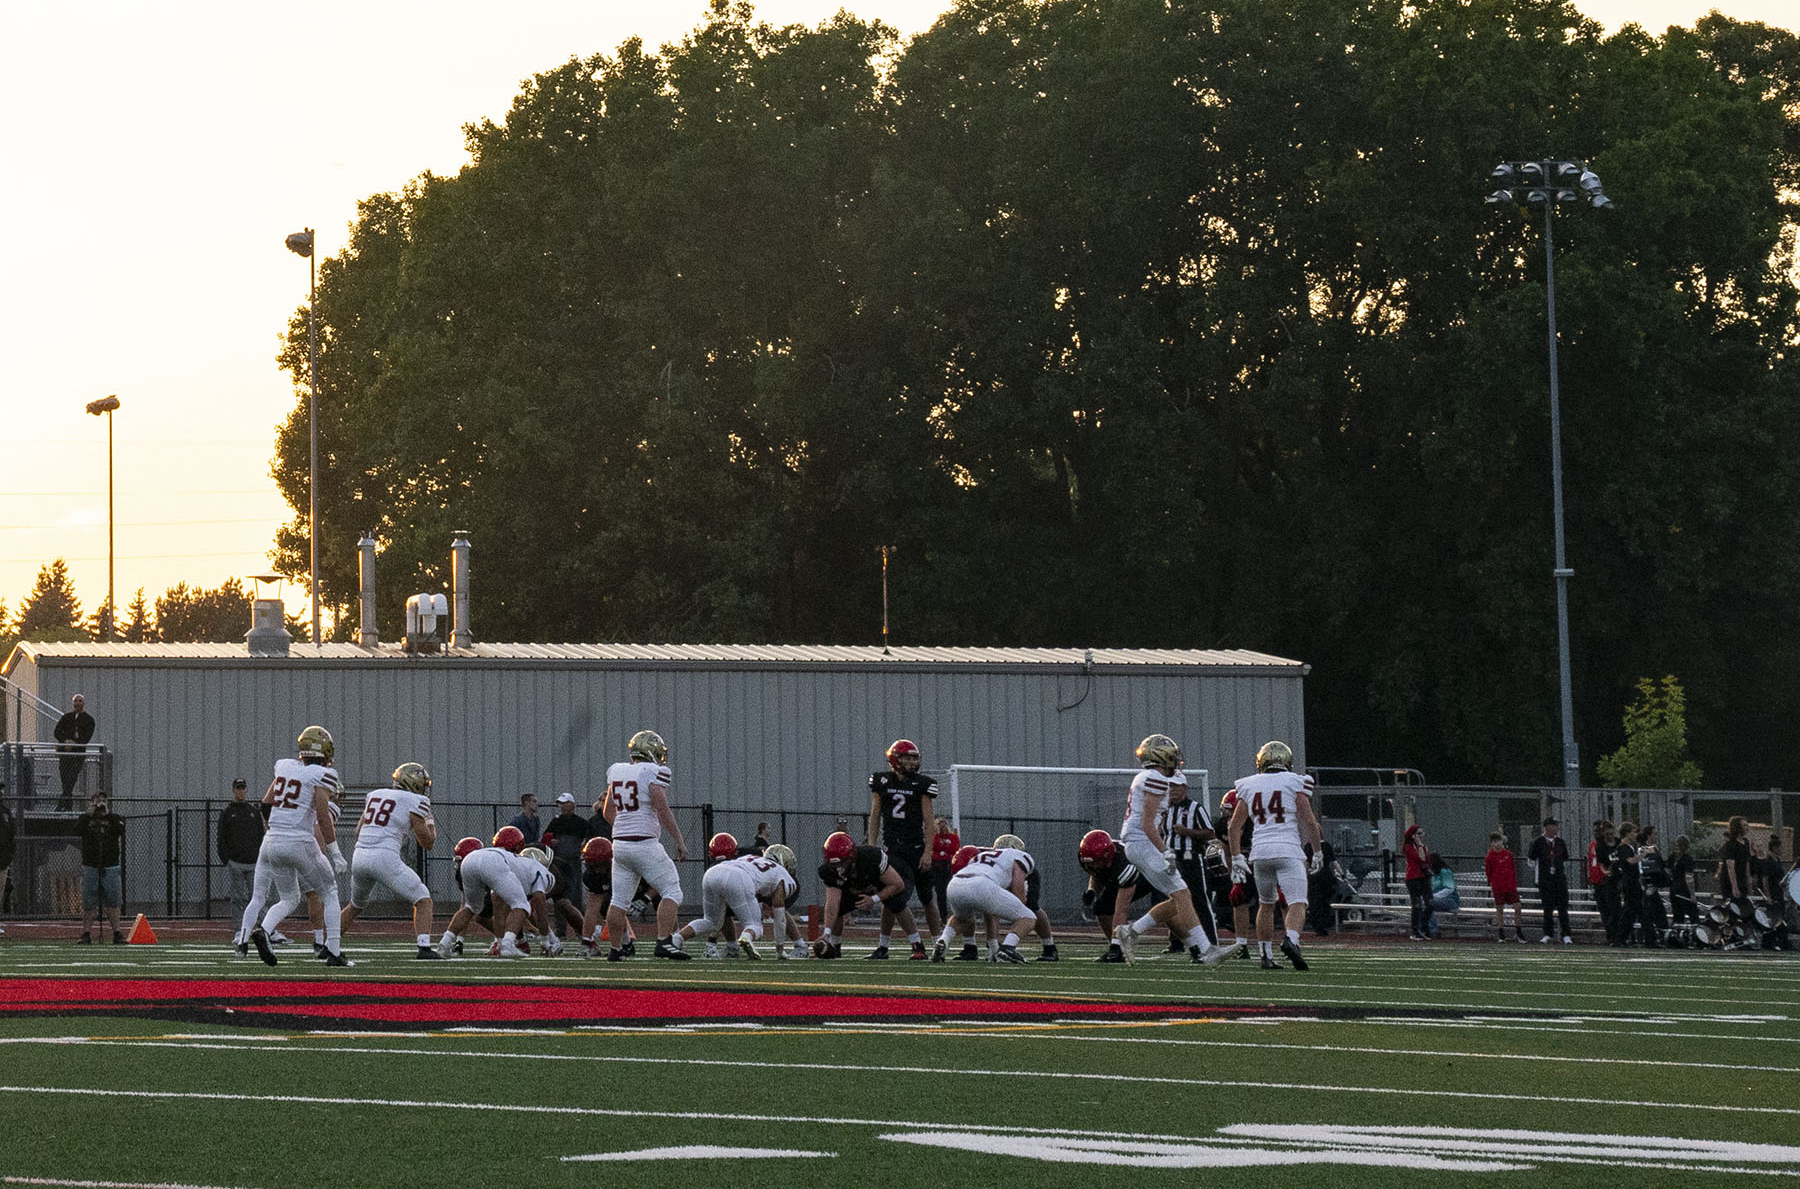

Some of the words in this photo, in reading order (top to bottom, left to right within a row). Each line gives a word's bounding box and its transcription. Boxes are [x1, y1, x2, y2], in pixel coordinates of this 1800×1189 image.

[271, 776, 302, 809] 22
[612, 781, 639, 811] 53
[891, 793, 906, 820] 2
[1251, 790, 1285, 824] 44
[364, 797, 396, 827] 58
